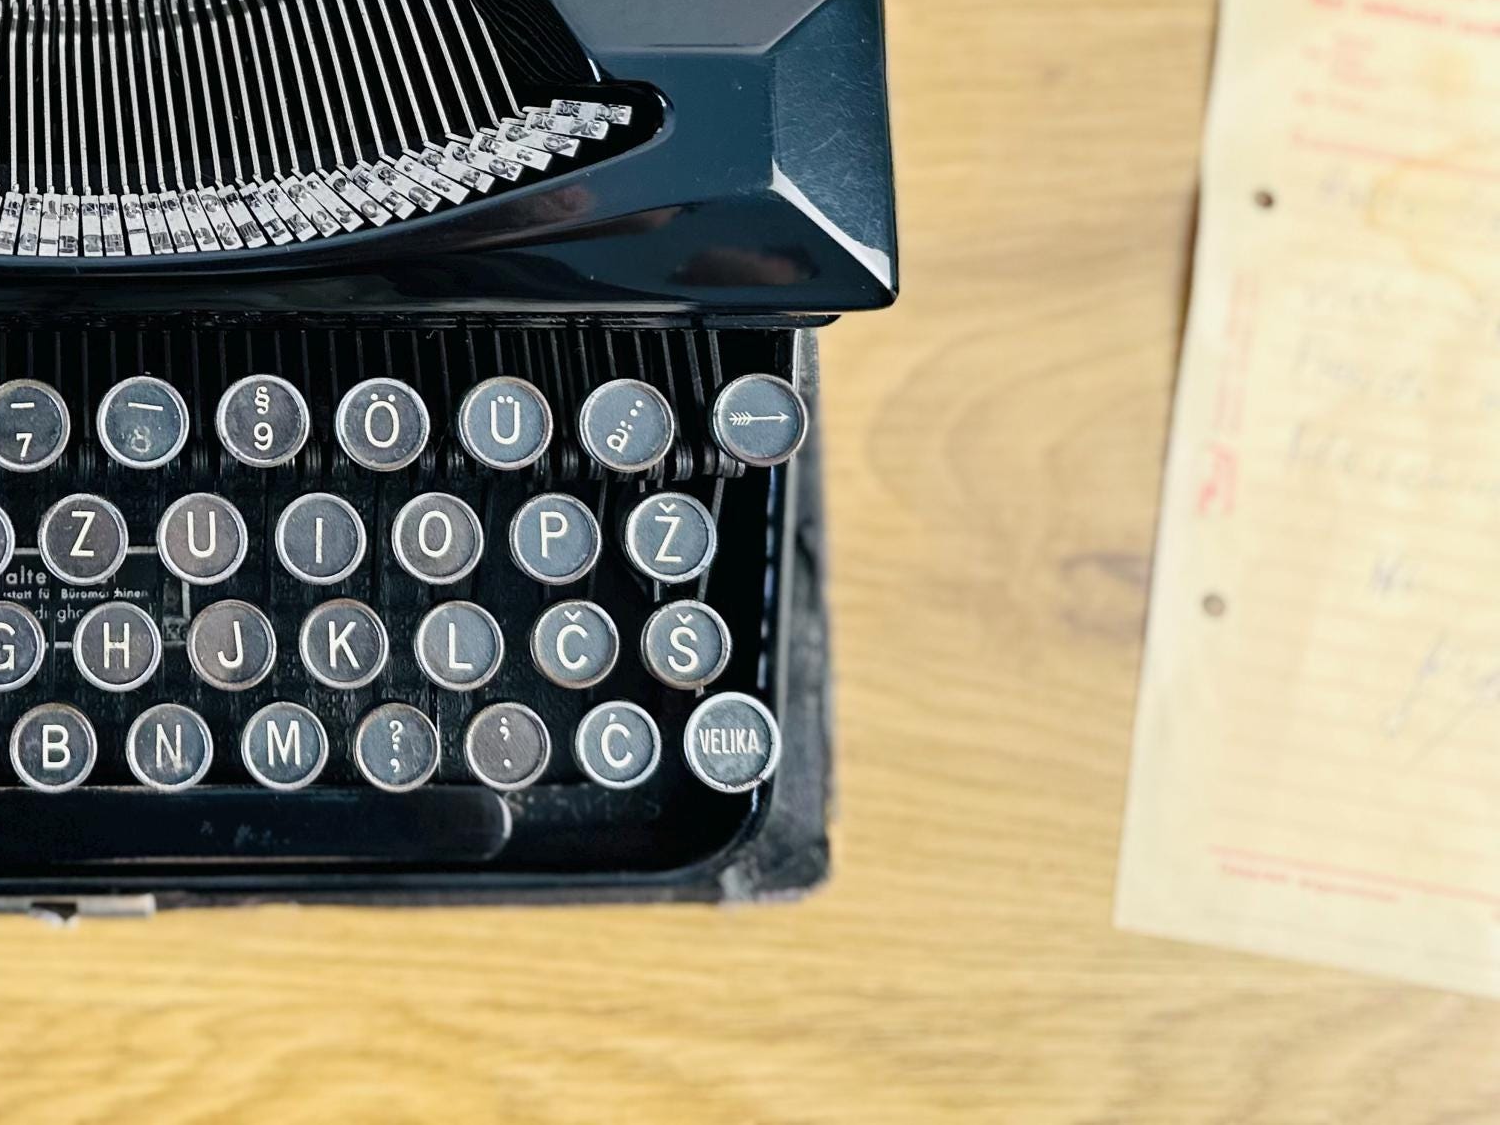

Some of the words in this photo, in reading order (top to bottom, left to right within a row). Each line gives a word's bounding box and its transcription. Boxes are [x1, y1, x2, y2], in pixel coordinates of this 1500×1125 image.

[17, 433, 32, 460] 7
[254, 423, 273, 450] 9
[364, 393, 400, 448] Ö
[491, 396, 520, 444] Ü
[70, 511, 95, 556] Z
[188, 512, 215, 557] U
[419, 511, 452, 557] O
[541, 512, 567, 557] P
[655, 502, 682, 562] Ž
[104, 623, 129, 668] H
[218, 621, 242, 668] J
[329, 621, 359, 667] K
[449, 623, 472, 669] L
[556, 610, 588, 669] Č
[668, 614, 698, 672] Š
[43, 725, 70, 768] B
[157, 724, 182, 769] N
[267, 721, 300, 765] M
[699, 729, 761, 754] VELIKA
